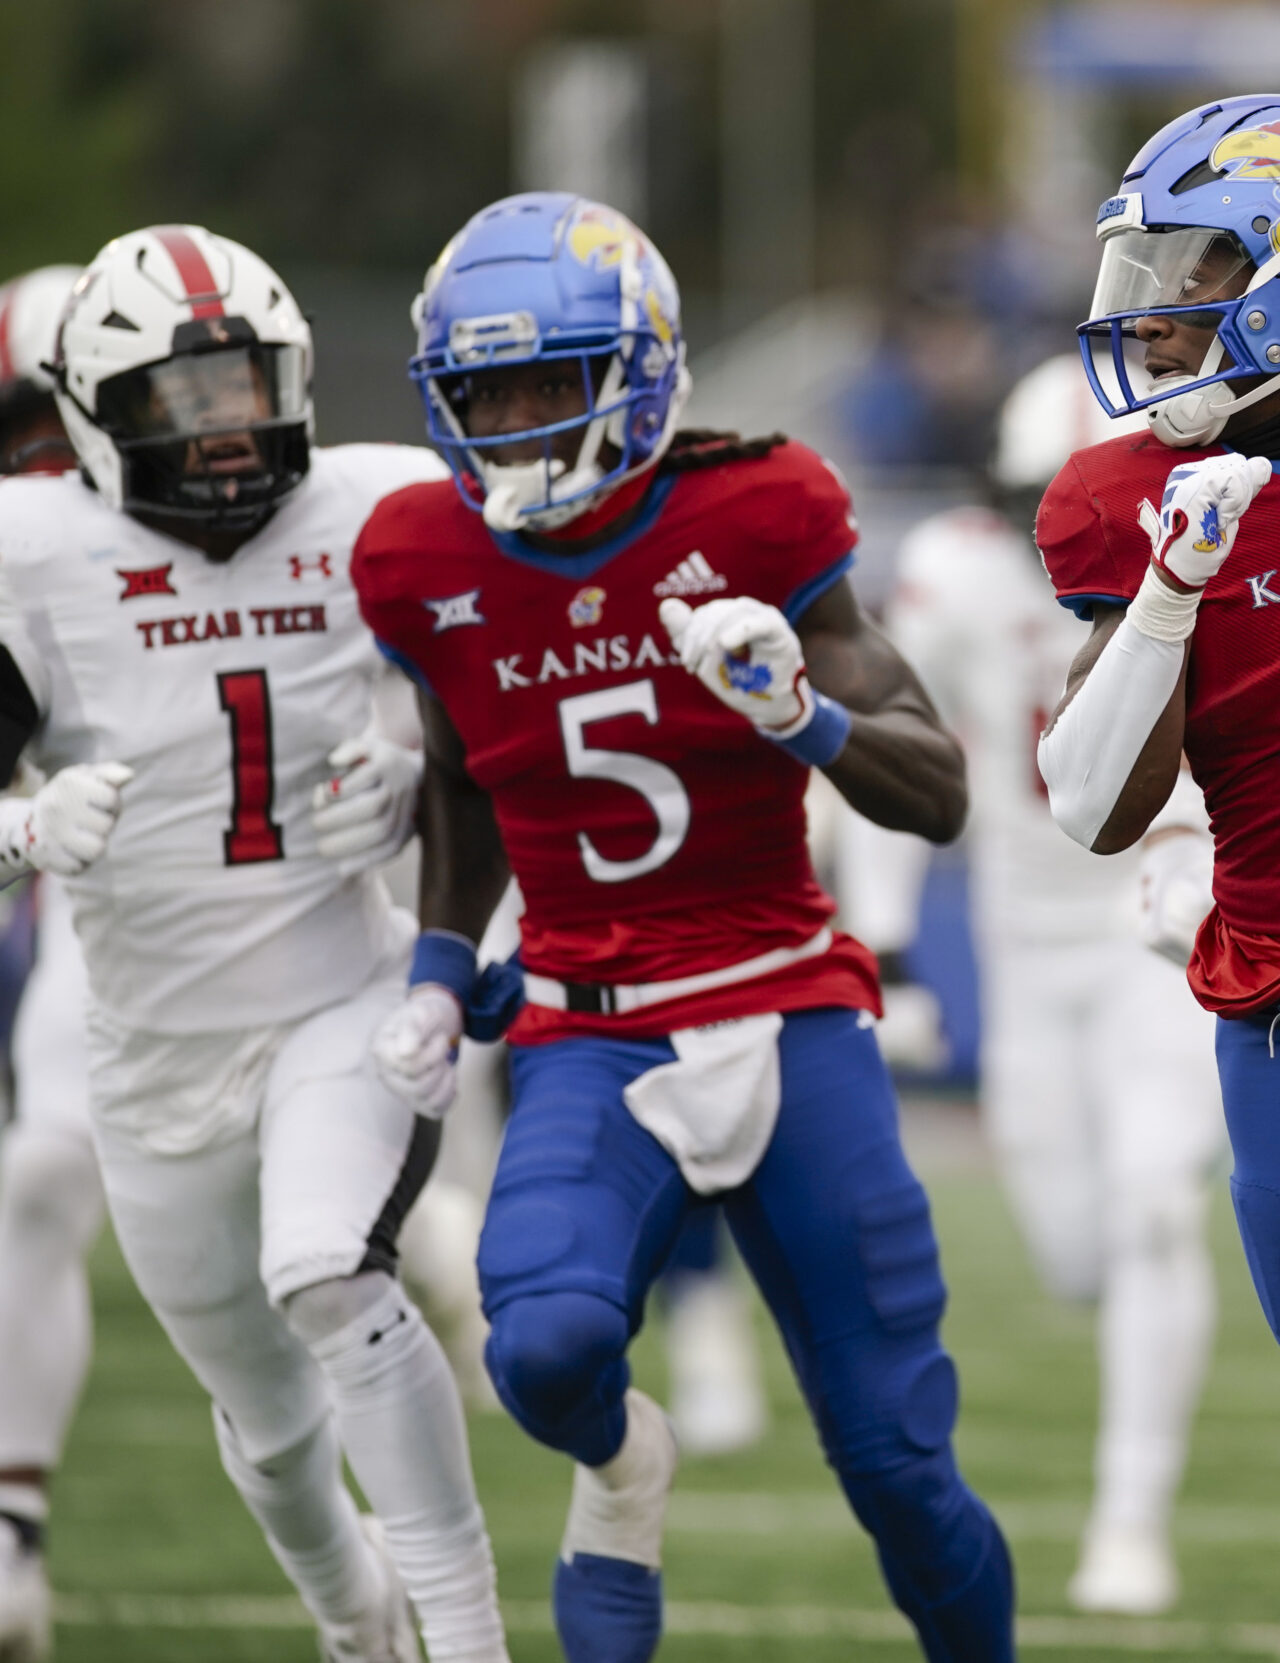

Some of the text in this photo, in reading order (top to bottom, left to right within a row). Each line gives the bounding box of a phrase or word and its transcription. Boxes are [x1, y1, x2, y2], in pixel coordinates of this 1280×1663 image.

[136, 604, 327, 648] TEXAS TECH
[493, 633, 682, 691] KANSA
[217, 669, 284, 867] 1
[558, 678, 691, 883] 5
